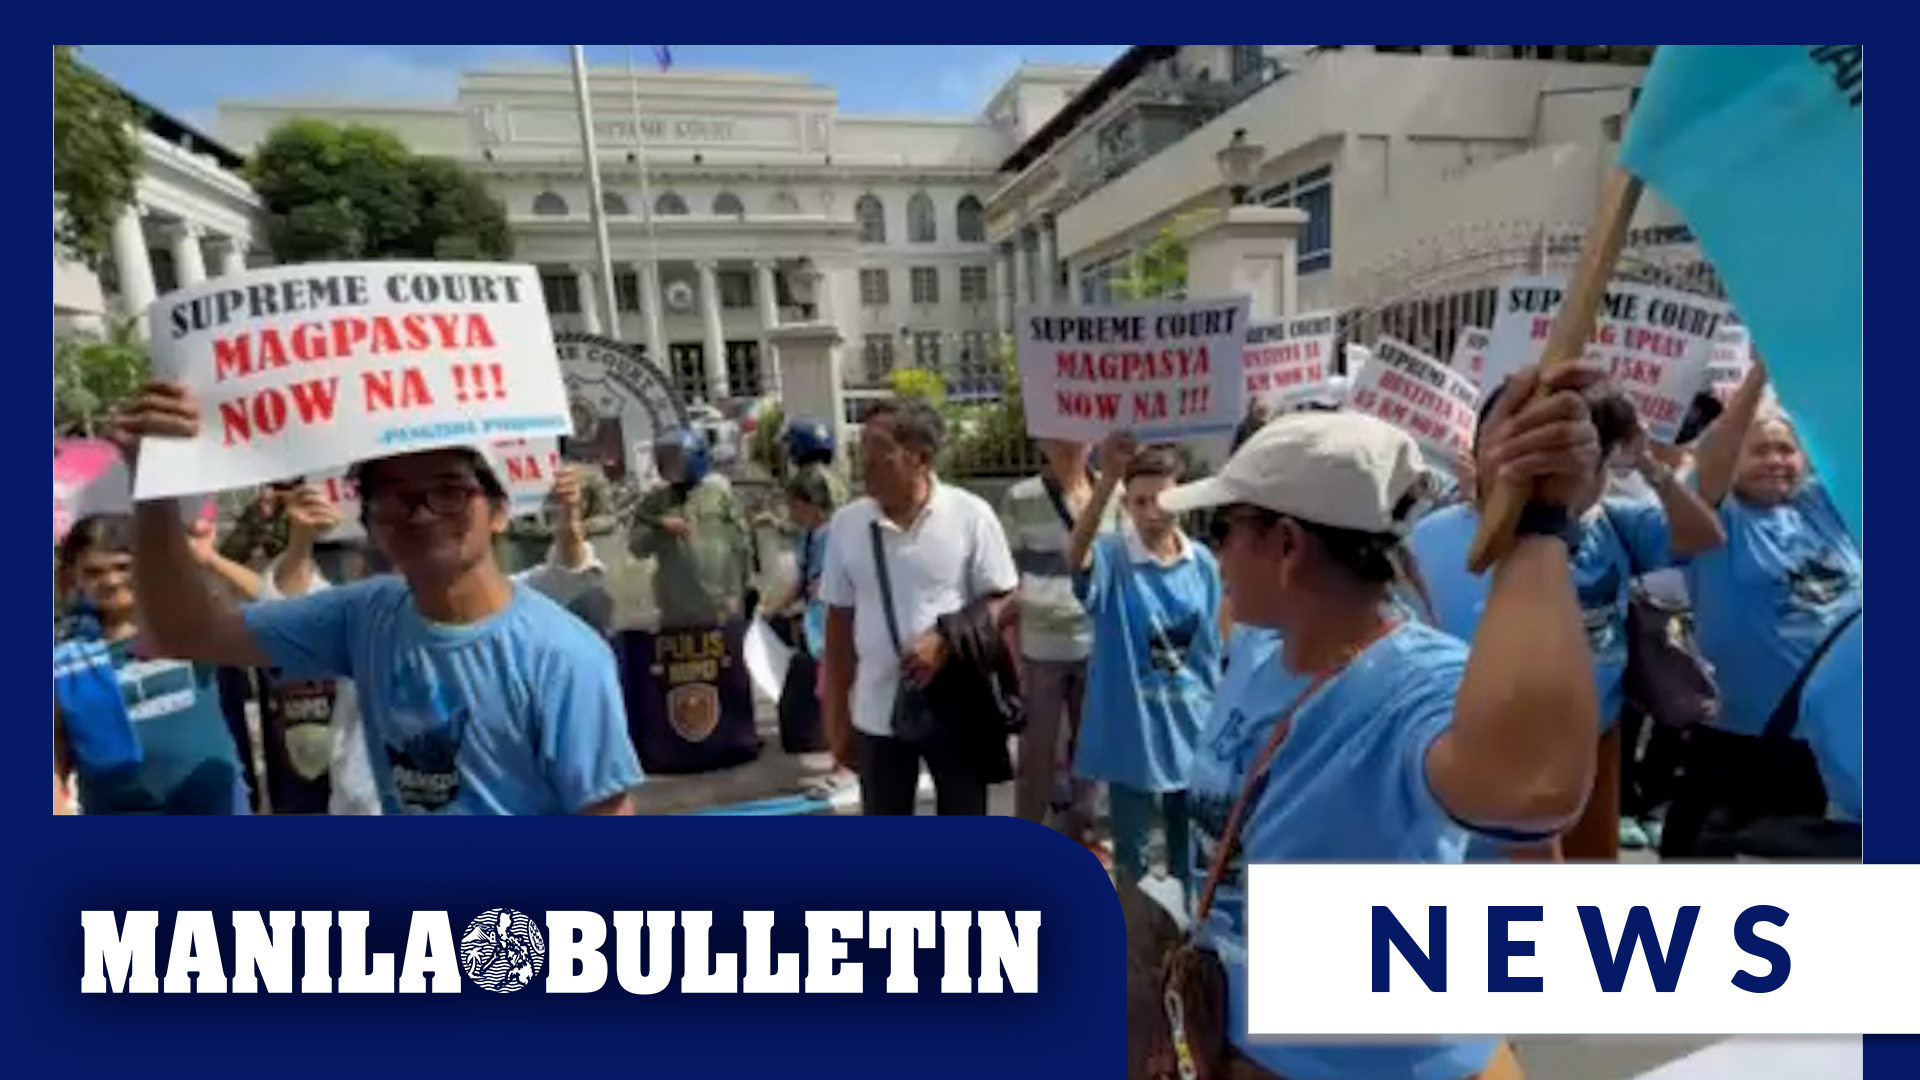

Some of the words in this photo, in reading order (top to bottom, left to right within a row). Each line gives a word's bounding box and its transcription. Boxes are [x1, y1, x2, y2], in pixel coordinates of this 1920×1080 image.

[171, 275, 368, 339] SUPREME
[386, 274, 523, 303] COURT
[1030, 316, 1146, 344] SUPREME
[1155, 306, 1241, 340] COURT
[1290, 316, 1331, 337] COURT
[1508, 286, 1639, 319] SUPME
[1648, 299, 1721, 339] COURT
[213, 313, 497, 382] MAGPASYA
[1055, 344, 1211, 383] MAGPASYA
[1376, 343, 1447, 389] SUPREME
[219, 377, 339, 447] NOW
[362, 366, 433, 410] NA
[451, 363, 508, 401] !!!
[1057, 391, 1119, 421] NOW
[1132, 389, 1167, 421] NA
[1179, 388, 1209, 416] !!!
[506, 454, 542, 481] NA
